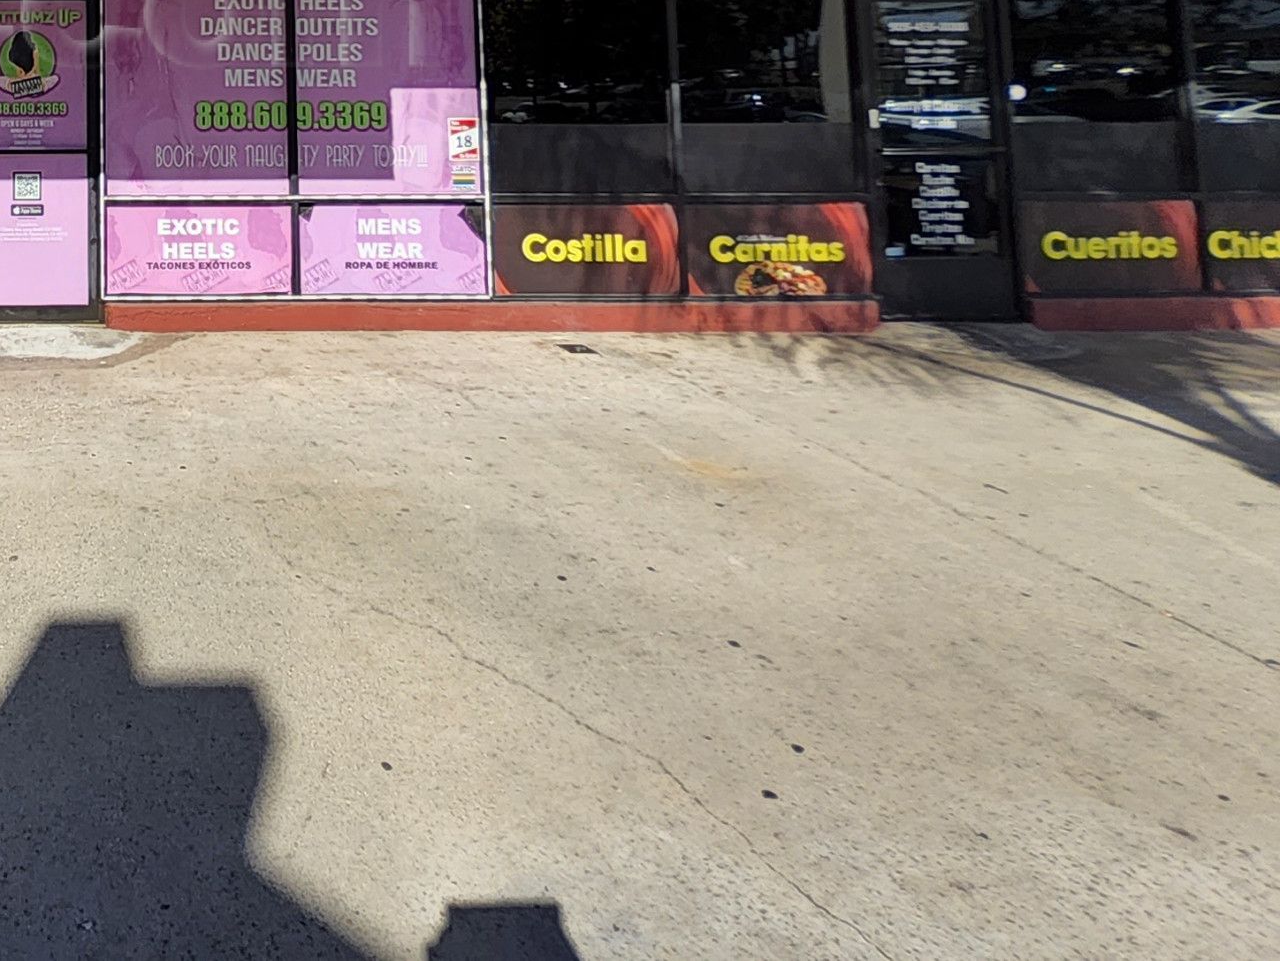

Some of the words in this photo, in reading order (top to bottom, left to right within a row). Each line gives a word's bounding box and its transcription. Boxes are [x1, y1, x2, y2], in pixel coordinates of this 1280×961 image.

[200, 18, 282, 36] DANCER
[296, 18, 378, 36] OUTFITS
[217, 43, 286, 62] DANCE
[299, 43, 363, 62] POLES
[224, 69, 284, 88] MENS
[298, 69, 357, 88] WEAR
[456, 136, 472, 148] 18
[156, 144, 194, 167] BOOK
[202, 144, 237, 167] YOUR
[326, 144, 363, 167] PARTY
[157, 218, 240, 235] EXOTIC
[357, 218, 422, 235] MENS
[163, 243, 235, 259] HEELS
[357, 243, 423, 259] WEAR
[522, 233, 647, 263] Costilla
[709, 235, 846, 263] Carnitas
[1041, 230, 1177, 259] Cueritos
[146, 261, 196, 270] TACONES
[345, 261, 373, 270] ROPA
[376, 261, 390, 270] DE
[392, 261, 438, 270] HOMBRE
